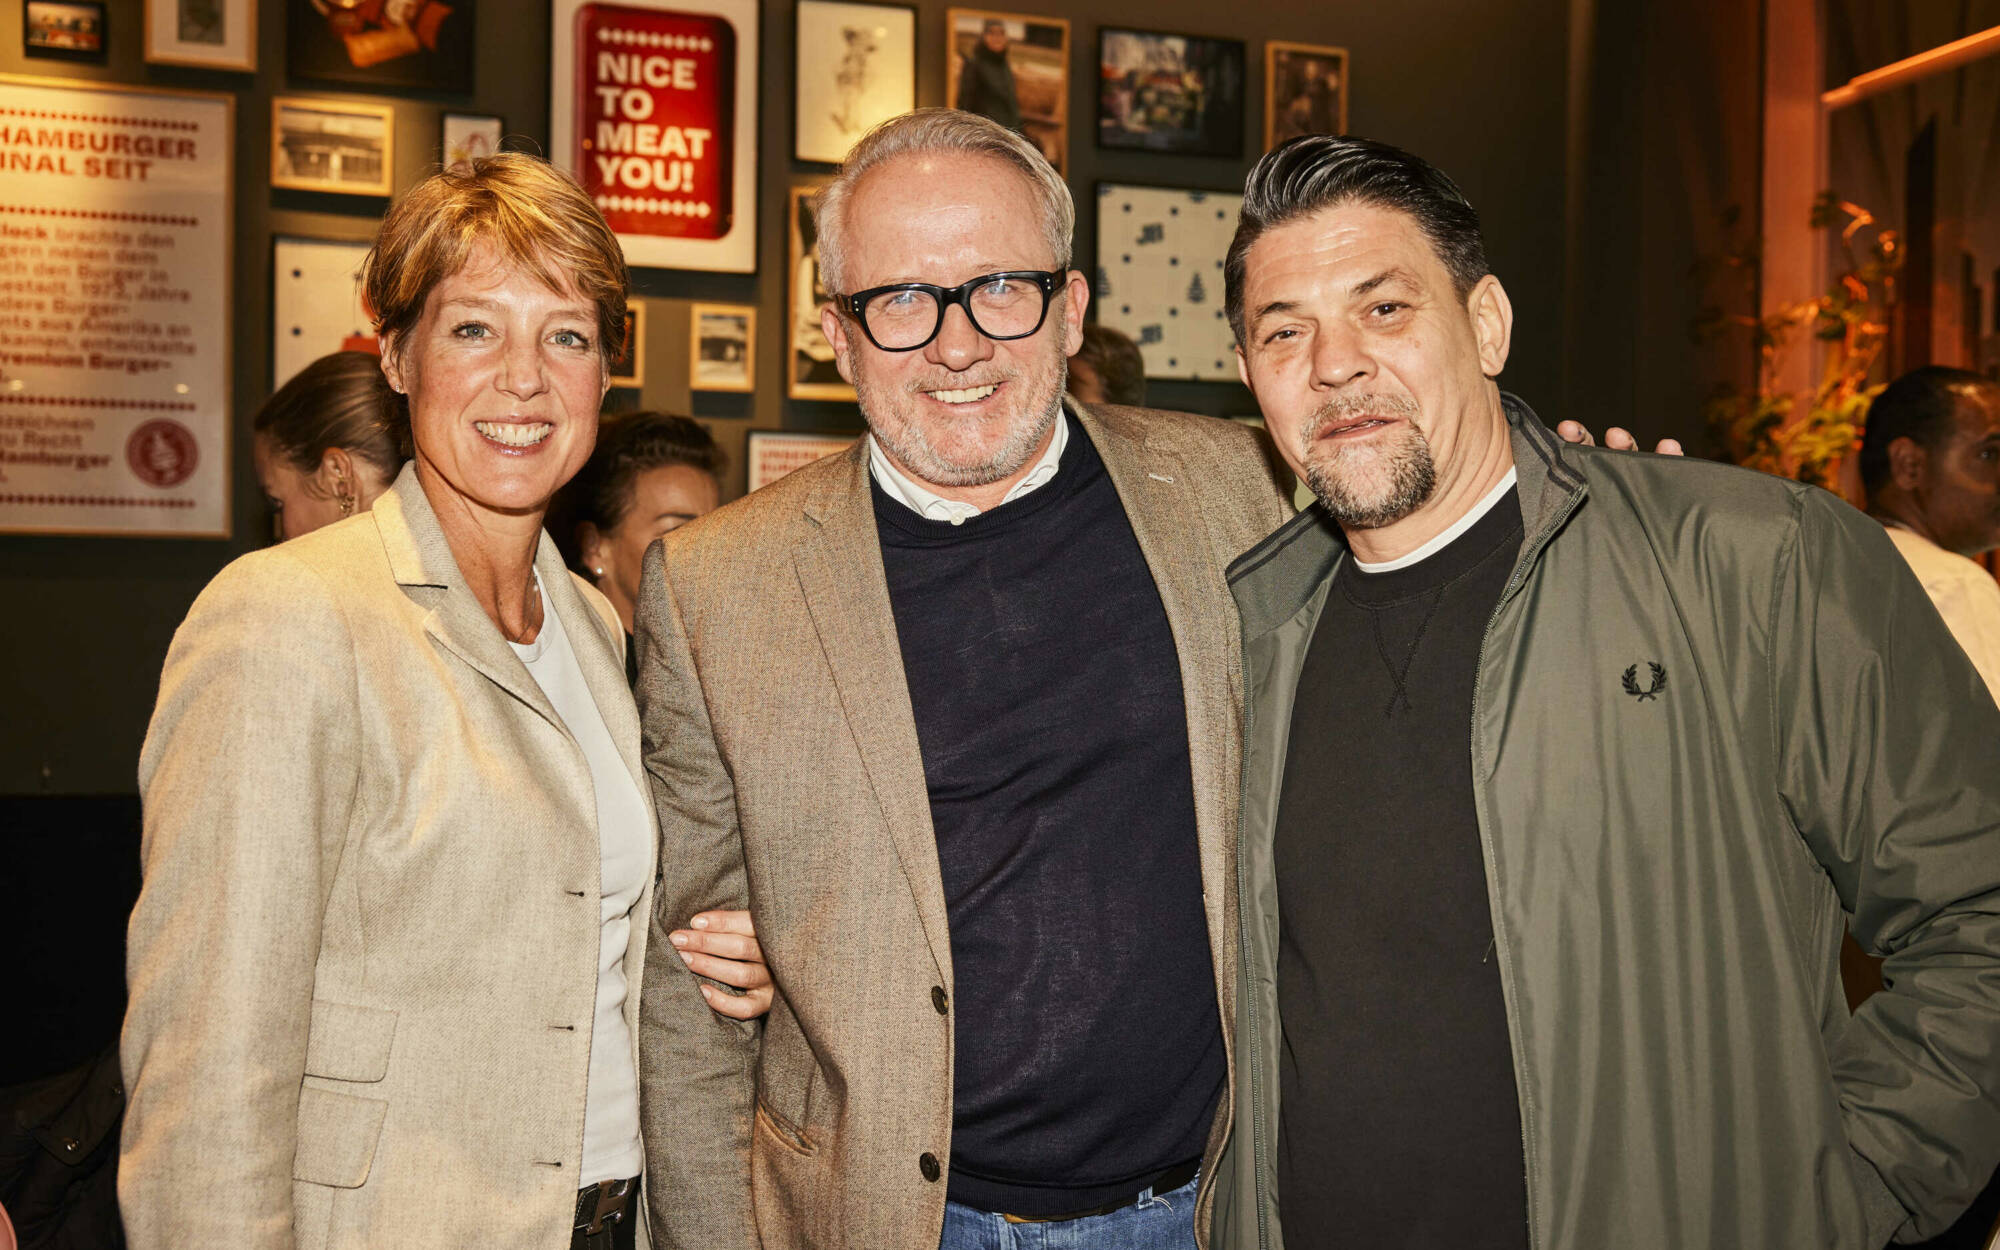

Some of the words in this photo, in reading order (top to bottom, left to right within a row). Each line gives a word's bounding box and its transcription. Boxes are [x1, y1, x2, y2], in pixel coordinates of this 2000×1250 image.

[598, 52, 697, 90] NICE
[596, 86, 654, 121] TO
[596, 122, 712, 160] MEAT
[83, 156, 153, 182] SEIT
[596, 155, 694, 193] YOU!
[77, 264, 145, 287] Burger
[136, 286, 191, 303] Jahre
[78, 318, 162, 336] Amerika
